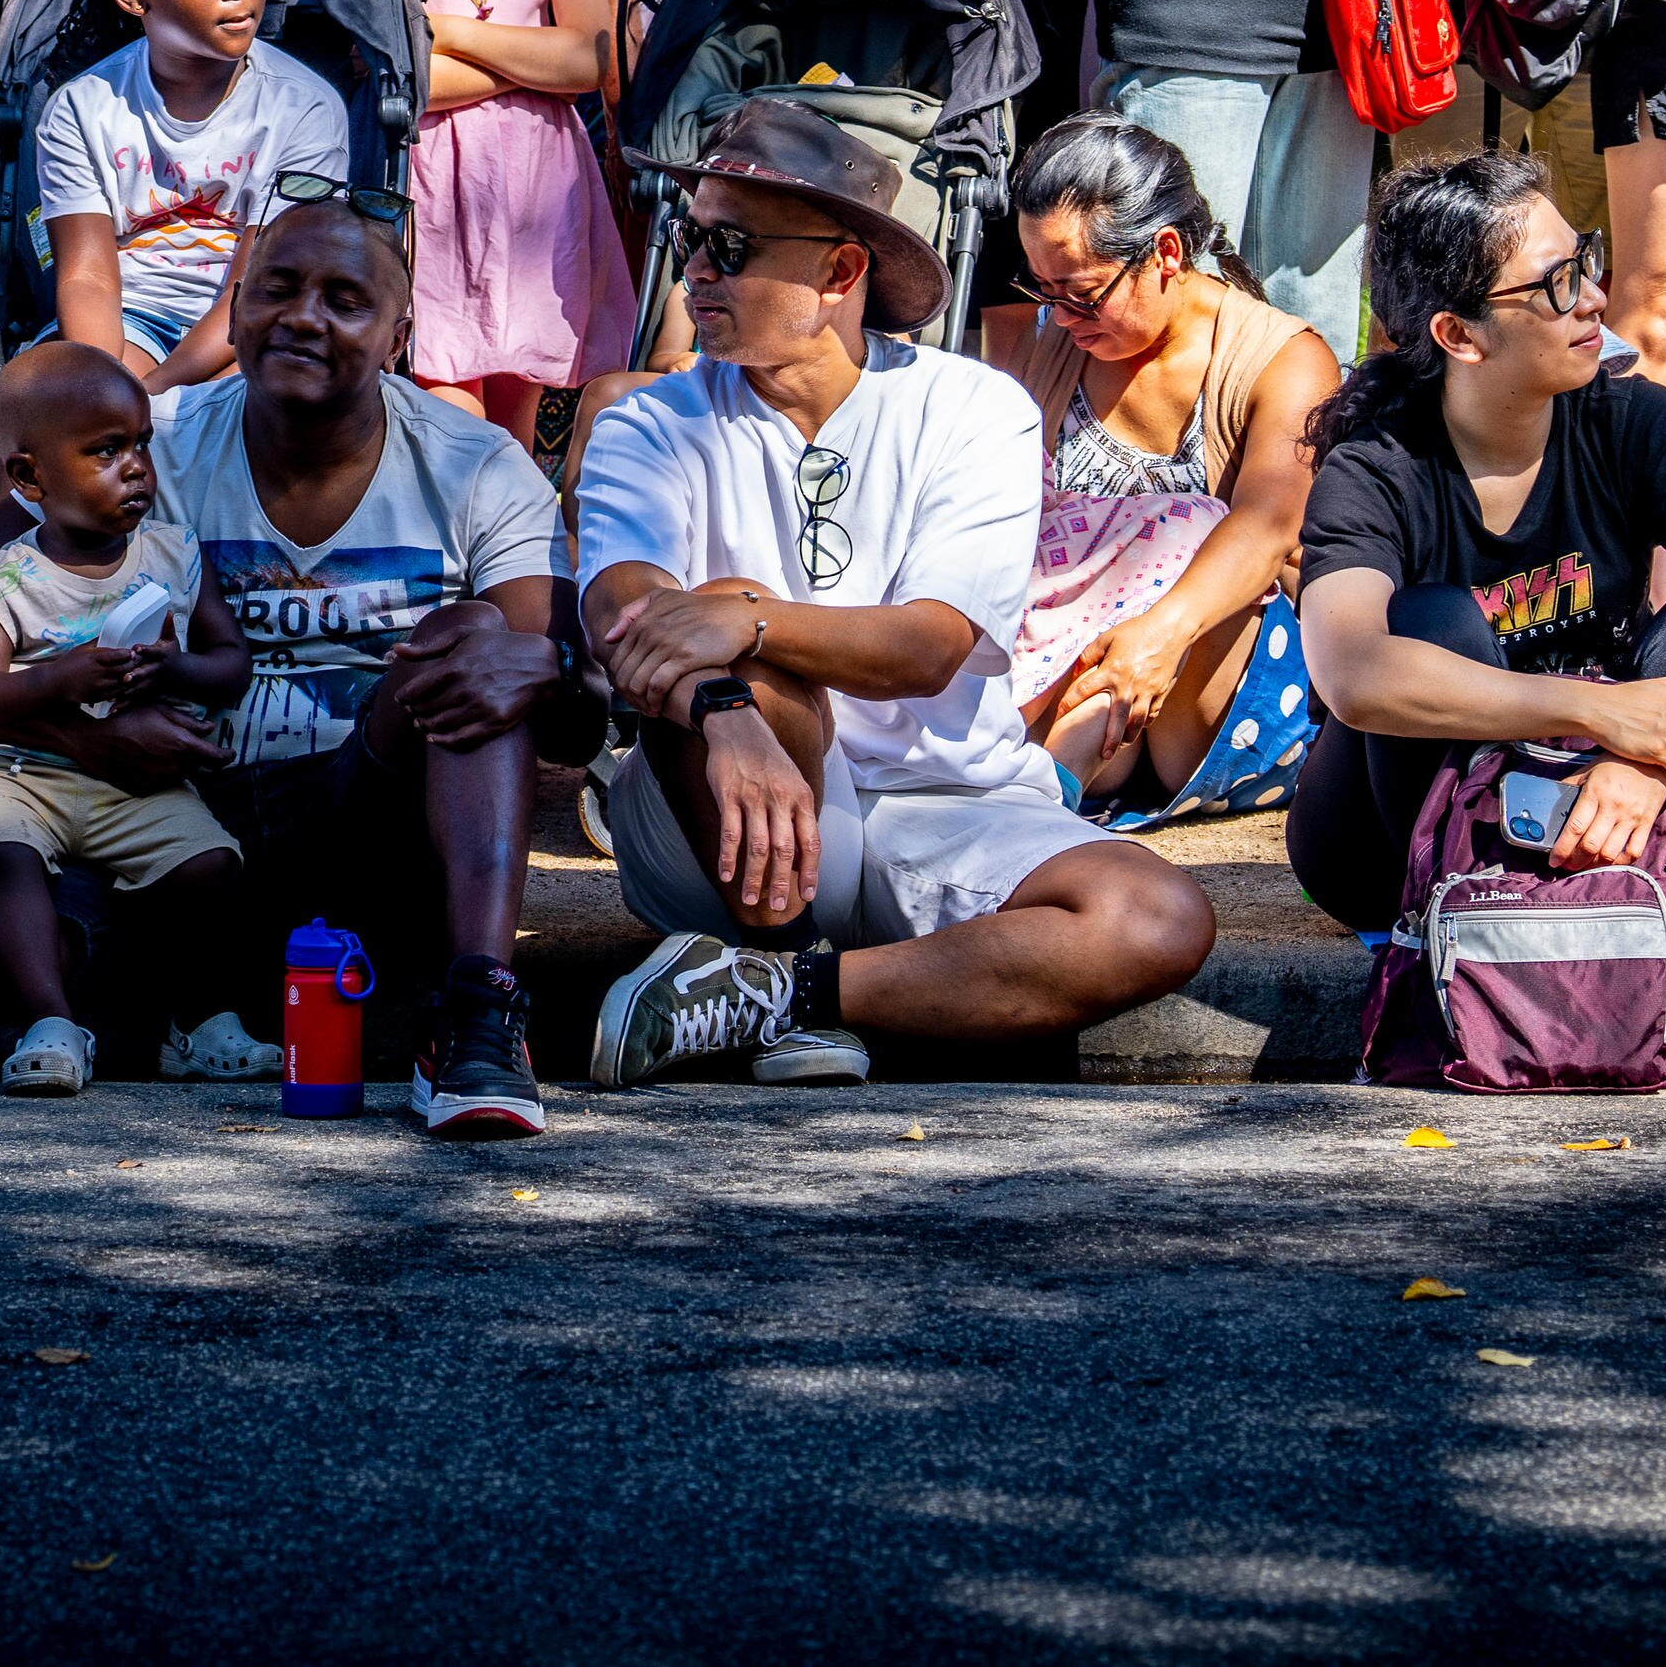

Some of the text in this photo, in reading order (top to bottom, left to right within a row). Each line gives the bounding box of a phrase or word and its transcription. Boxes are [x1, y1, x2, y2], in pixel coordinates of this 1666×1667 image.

[1470, 551, 1594, 636] KISS
[1498, 609, 1597, 646] STROYER
[289, 1044, 297, 1084] uaFlask
